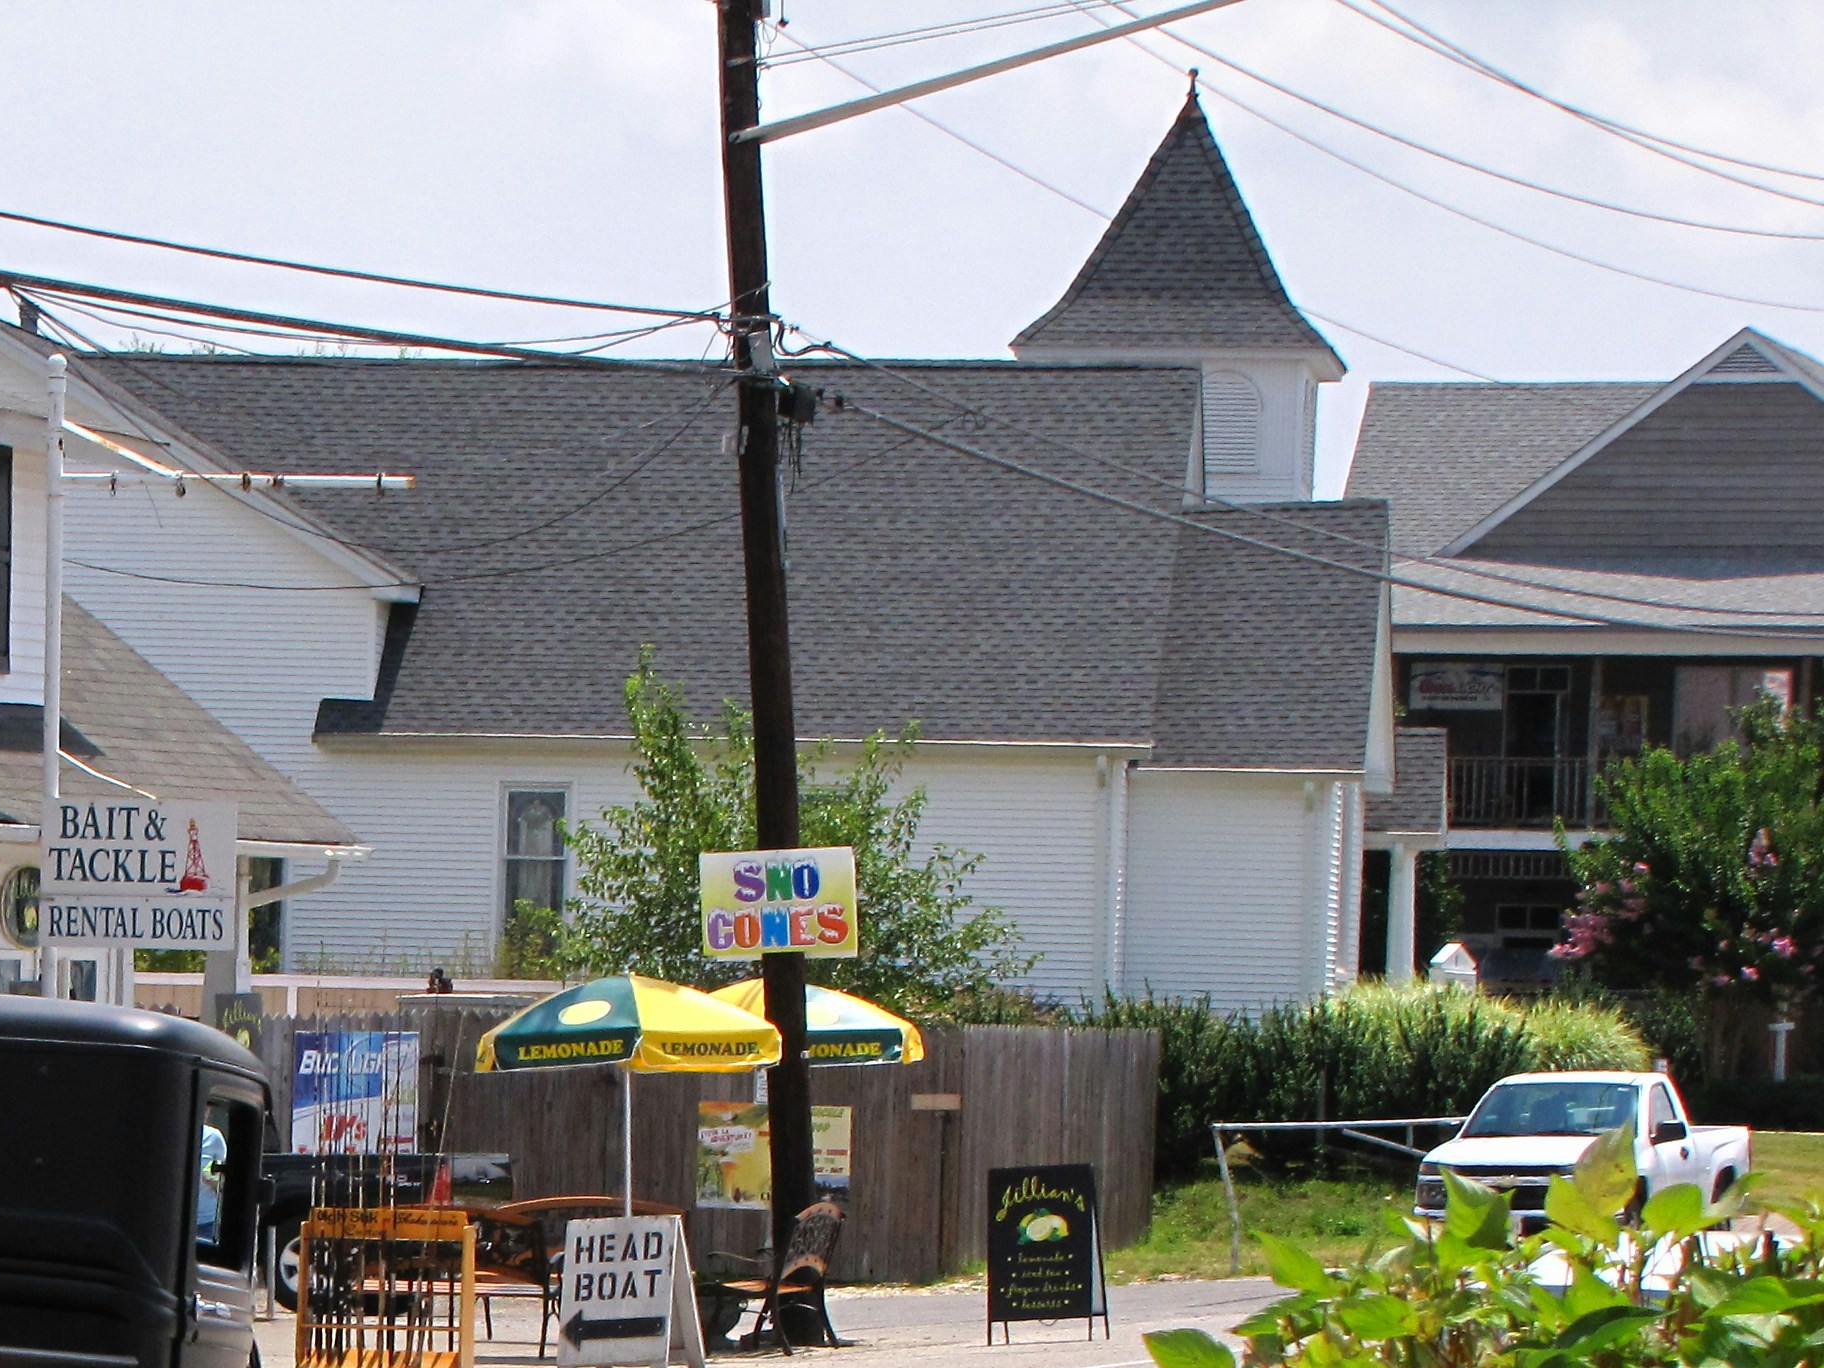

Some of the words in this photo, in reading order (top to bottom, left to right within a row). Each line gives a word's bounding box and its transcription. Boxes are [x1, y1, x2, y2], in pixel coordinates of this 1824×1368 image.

[60, 805, 140, 840] BAIT
[144, 809, 167, 841] &
[49, 848, 177, 883] TACKLE
[733, 858, 820, 902] SNO
[48, 905, 144, 939] RENTAL
[151, 907, 224, 941] BOATS
[707, 903, 849, 949] CONES
[517, 1039, 624, 1061] LEMONADE
[661, 1041, 760, 1056] LEMONADE
[575, 1231, 663, 1264] HEAD
[574, 1269, 663, 1301] BOAT
